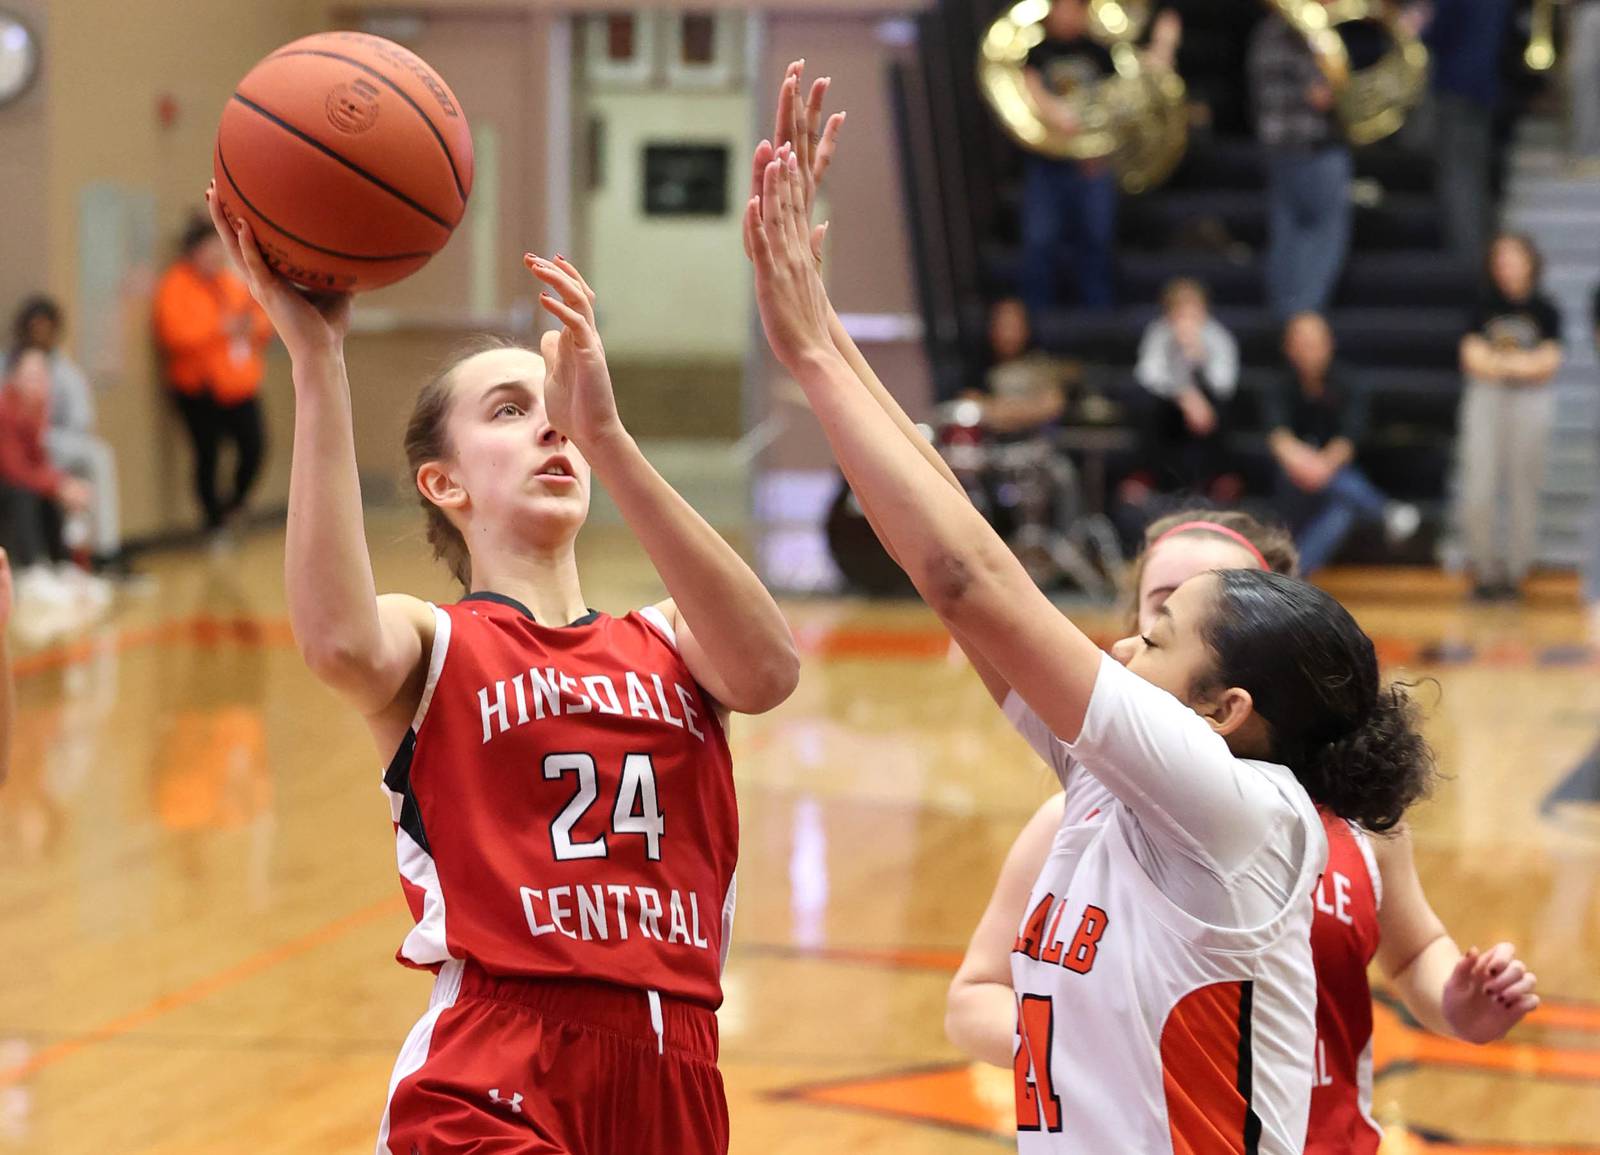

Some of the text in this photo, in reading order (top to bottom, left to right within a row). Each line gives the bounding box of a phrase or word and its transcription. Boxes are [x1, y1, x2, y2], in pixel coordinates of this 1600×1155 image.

[477, 667, 704, 744] HINSDALE
[542, 752, 665, 861] 24
[519, 884, 708, 949] CENTRAL
[1011, 892, 1109, 975] ALB
